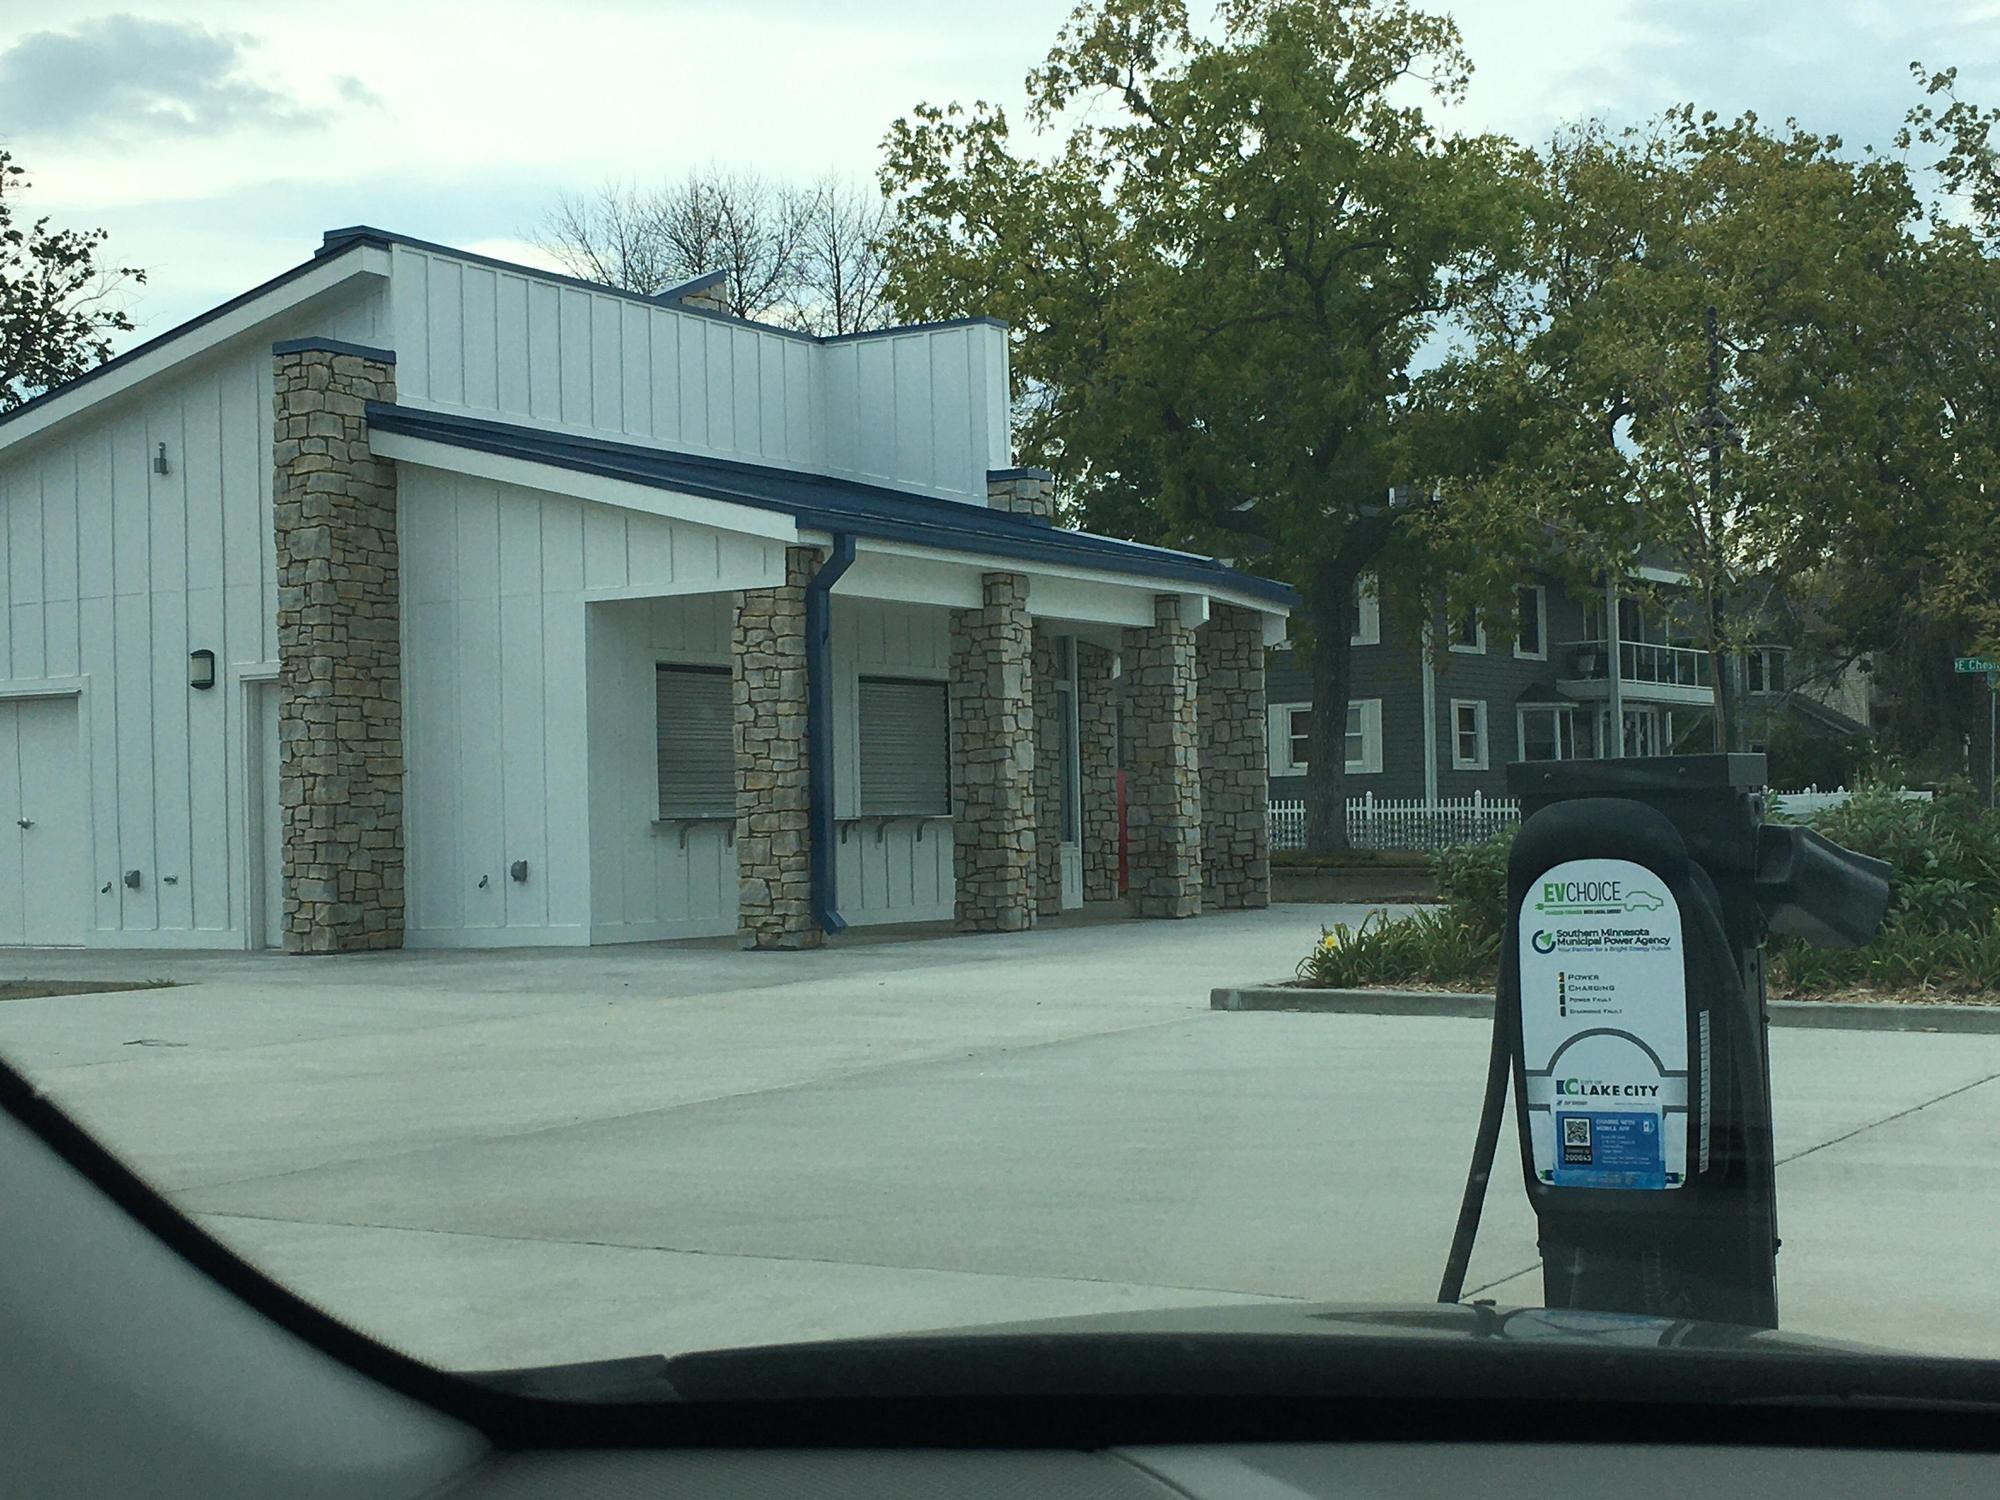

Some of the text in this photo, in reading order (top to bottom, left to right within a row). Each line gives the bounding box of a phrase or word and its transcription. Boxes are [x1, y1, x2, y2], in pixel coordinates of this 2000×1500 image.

[1556, 928, 1650, 938] Southern Minnesota
[1556, 936, 1671, 946] Municipal Power Agency
[1580, 1085, 1659, 1097] LAKE CITY
